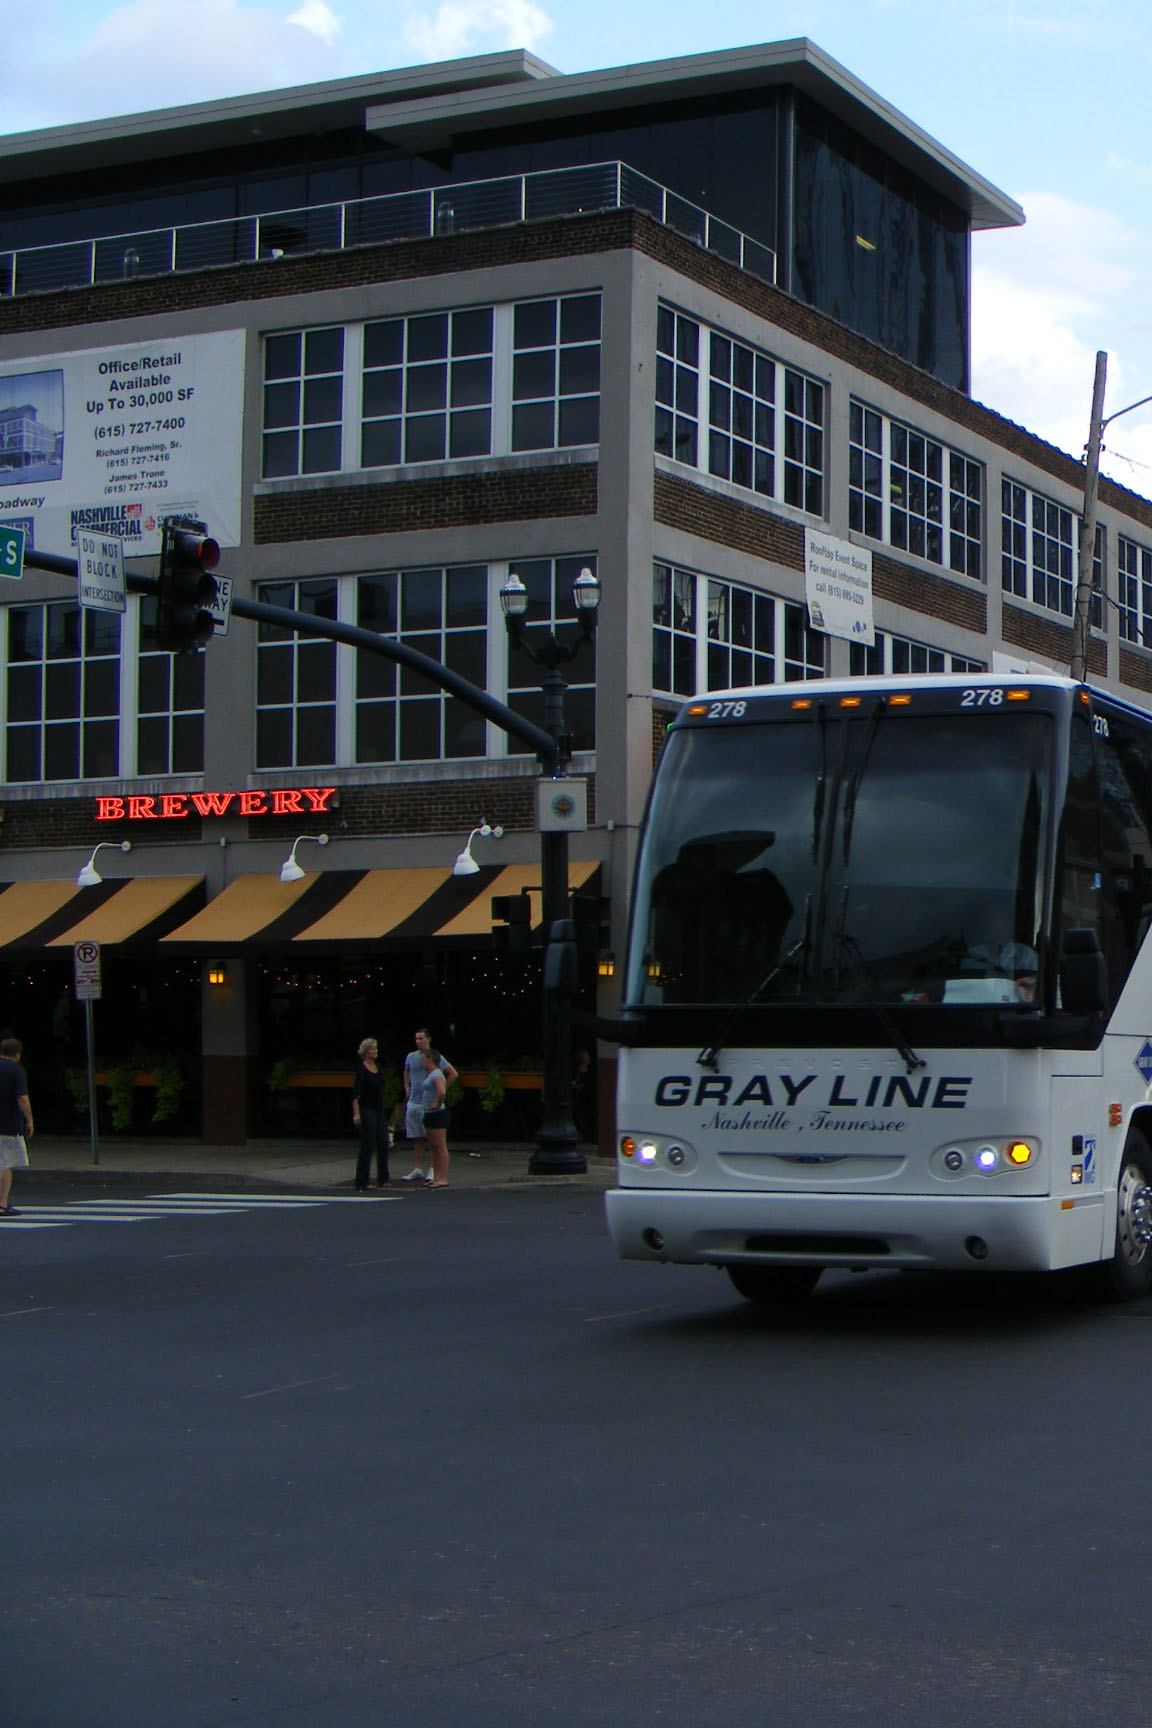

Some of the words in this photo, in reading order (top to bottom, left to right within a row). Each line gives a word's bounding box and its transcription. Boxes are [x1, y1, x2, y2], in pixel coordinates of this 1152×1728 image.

[98, 352, 182, 374] Office/Retail
[109, 374, 171, 392] Available
[86, 400, 104, 414] Up
[108, 398, 125, 410] To
[129, 390, 173, 408] 30,000
[177, 387, 195, 401] SF
[94, 423, 125, 440] (615)
[129, 417, 185, 435] 727-7400
[96, 447, 129, 458] Richard
[170, 440, 182, 449] Sr.
[106, 457, 128, 469] (615)
[131, 453, 170, 465] 727-7416
[109, 473, 137, 483] James
[140, 470, 165, 479] Trone
[104, 483, 127, 495] (615)
[129, 480, 168, 492] 727-7433
[70, 504, 127, 525] NASHVILLE
[6, 540, 18, 565] S
[82, 538, 95, 554] DO
[102, 542, 118, 559] NOT
[810, 542, 834, 561] Rooftop
[835, 550, 850, 565] Event
[86, 559, 118, 579] BLOCK
[809, 560, 819, 573] For
[82, 586, 125, 604] INTERSECTION
[961, 689, 1004, 707] 278
[707, 701, 746, 719] 278
[1093, 713, 1110, 737] 278
[95, 787, 336, 821] BREWERY
[654, 1074, 818, 1108] GRAY
[827, 1075, 973, 1109] LINE
[701, 1111, 791, 1130] Nashville
[810, 1110, 909, 1132] Tennessee
